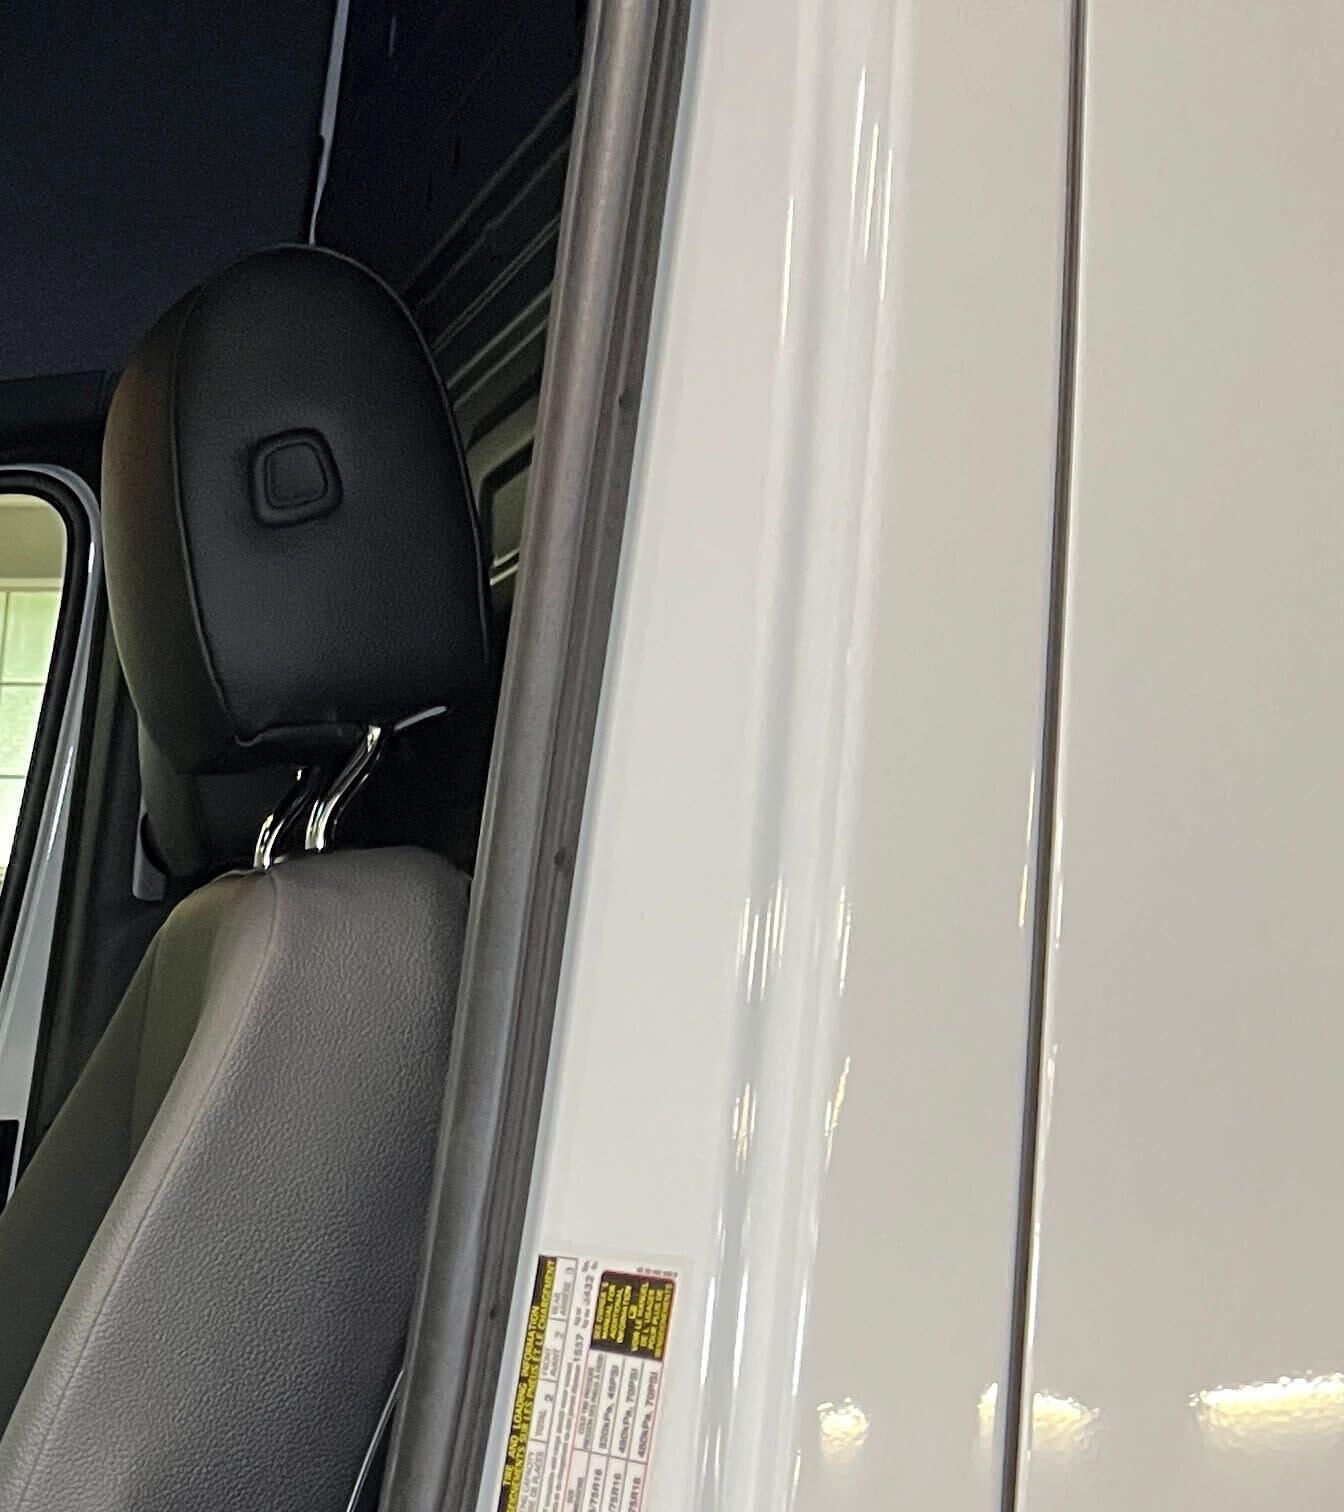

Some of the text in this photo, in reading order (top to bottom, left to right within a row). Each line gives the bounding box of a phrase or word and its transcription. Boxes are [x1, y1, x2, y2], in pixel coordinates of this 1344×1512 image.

[538, 1260, 554, 1329] CHARGEMENT
[503, 1305, 538, 1486] TIRE AND LOADING INFORMATION
[527, 1364, 538, 1397] PNEUS
[523, 1400, 532, 1419] LES
[519, 1423, 528, 1442] SUR
